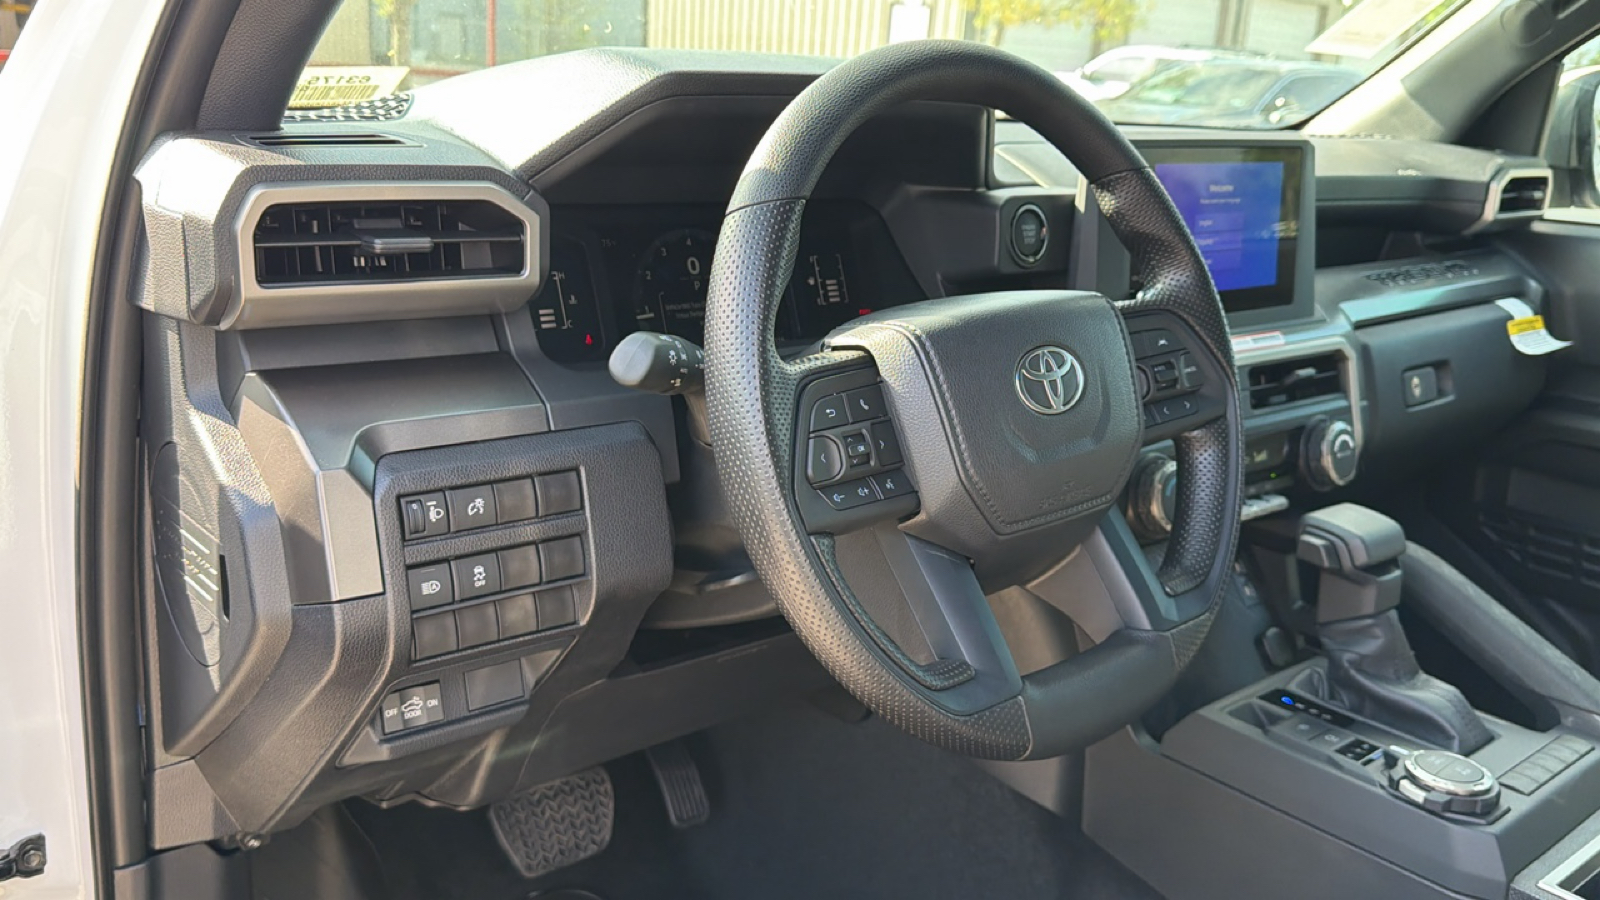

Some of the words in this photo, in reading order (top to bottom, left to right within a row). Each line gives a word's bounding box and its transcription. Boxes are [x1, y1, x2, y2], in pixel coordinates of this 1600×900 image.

[661, 247, 667, 256] 3
[687, 256, 700, 275] 0
[645, 270, 651, 280] 2
[694, 280, 701, 291] P
[474, 579, 486, 587] OFF
[426, 698, 439, 708] ON
[385, 707, 398, 717] OFF
[404, 709, 422, 719] DOOR
